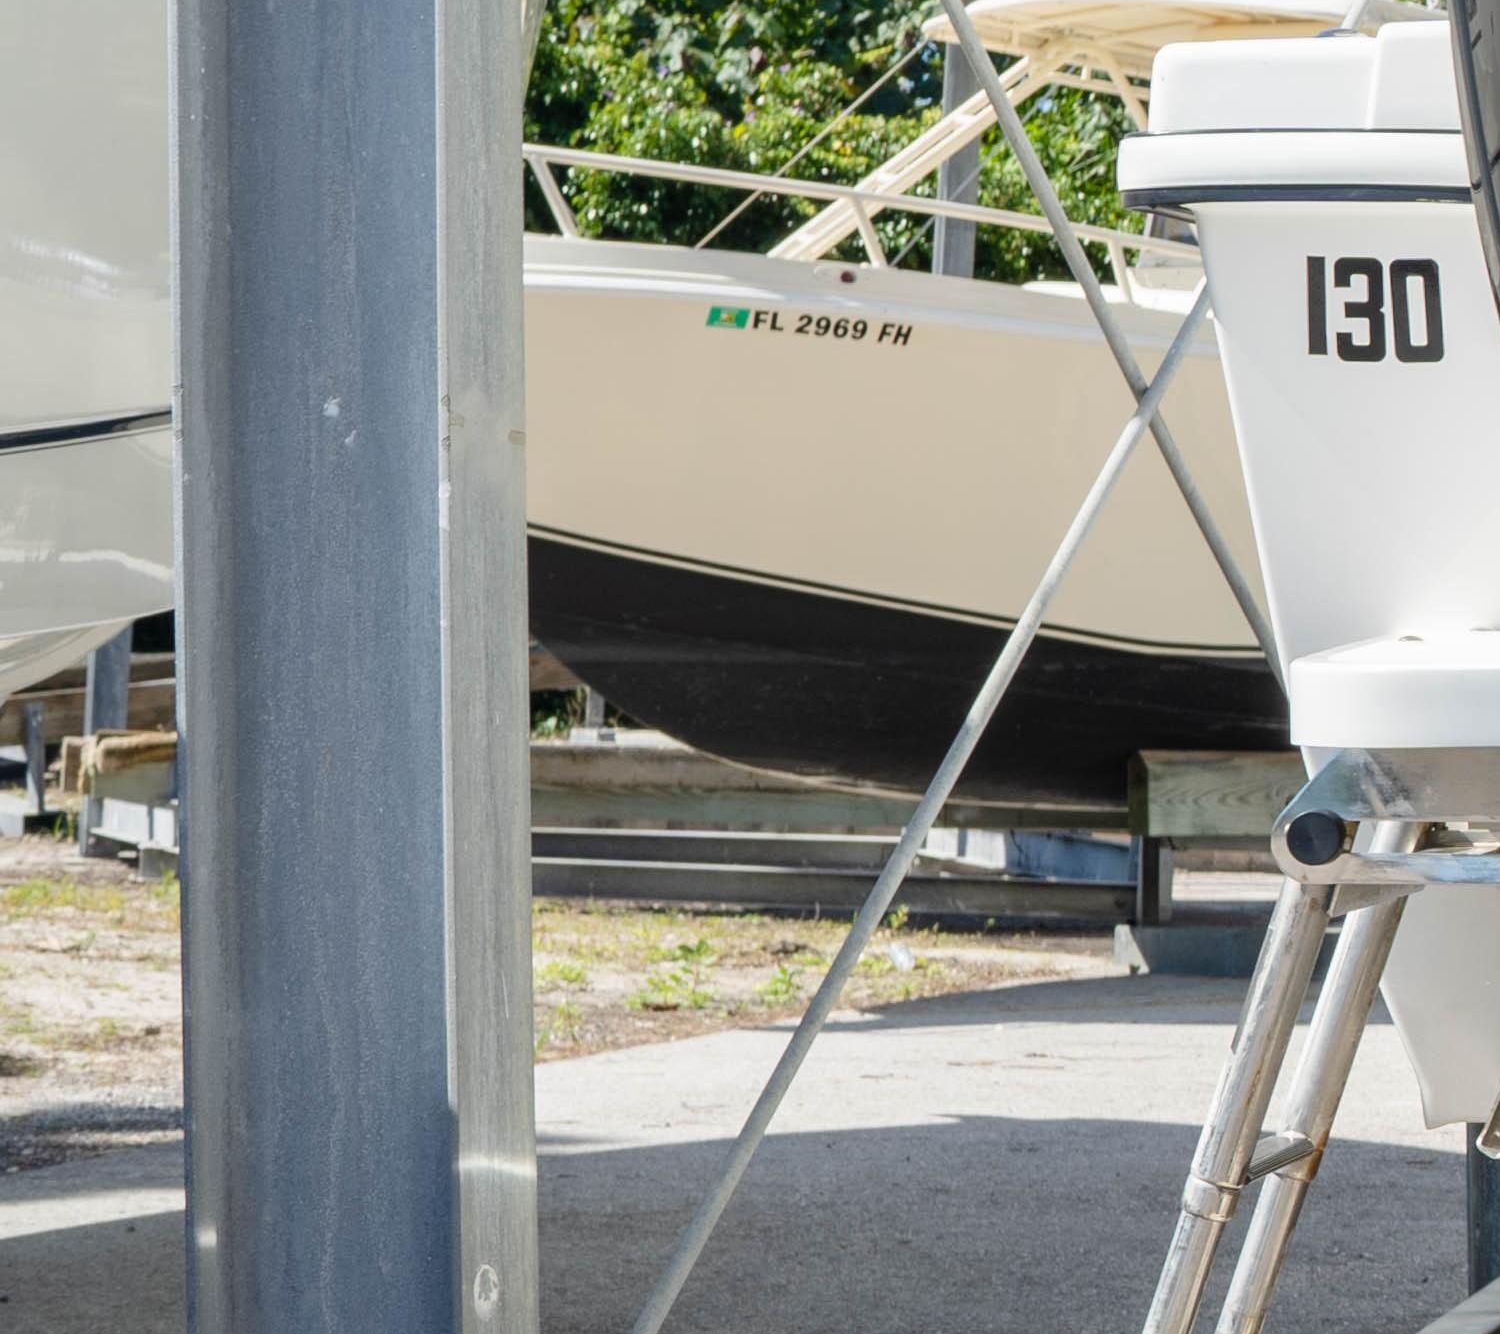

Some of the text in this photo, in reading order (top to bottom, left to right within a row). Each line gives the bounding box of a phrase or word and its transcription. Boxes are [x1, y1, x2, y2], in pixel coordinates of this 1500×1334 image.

[752, 310, 913, 346] FL 2969 FH
[1307, 256, 1445, 363] 130
